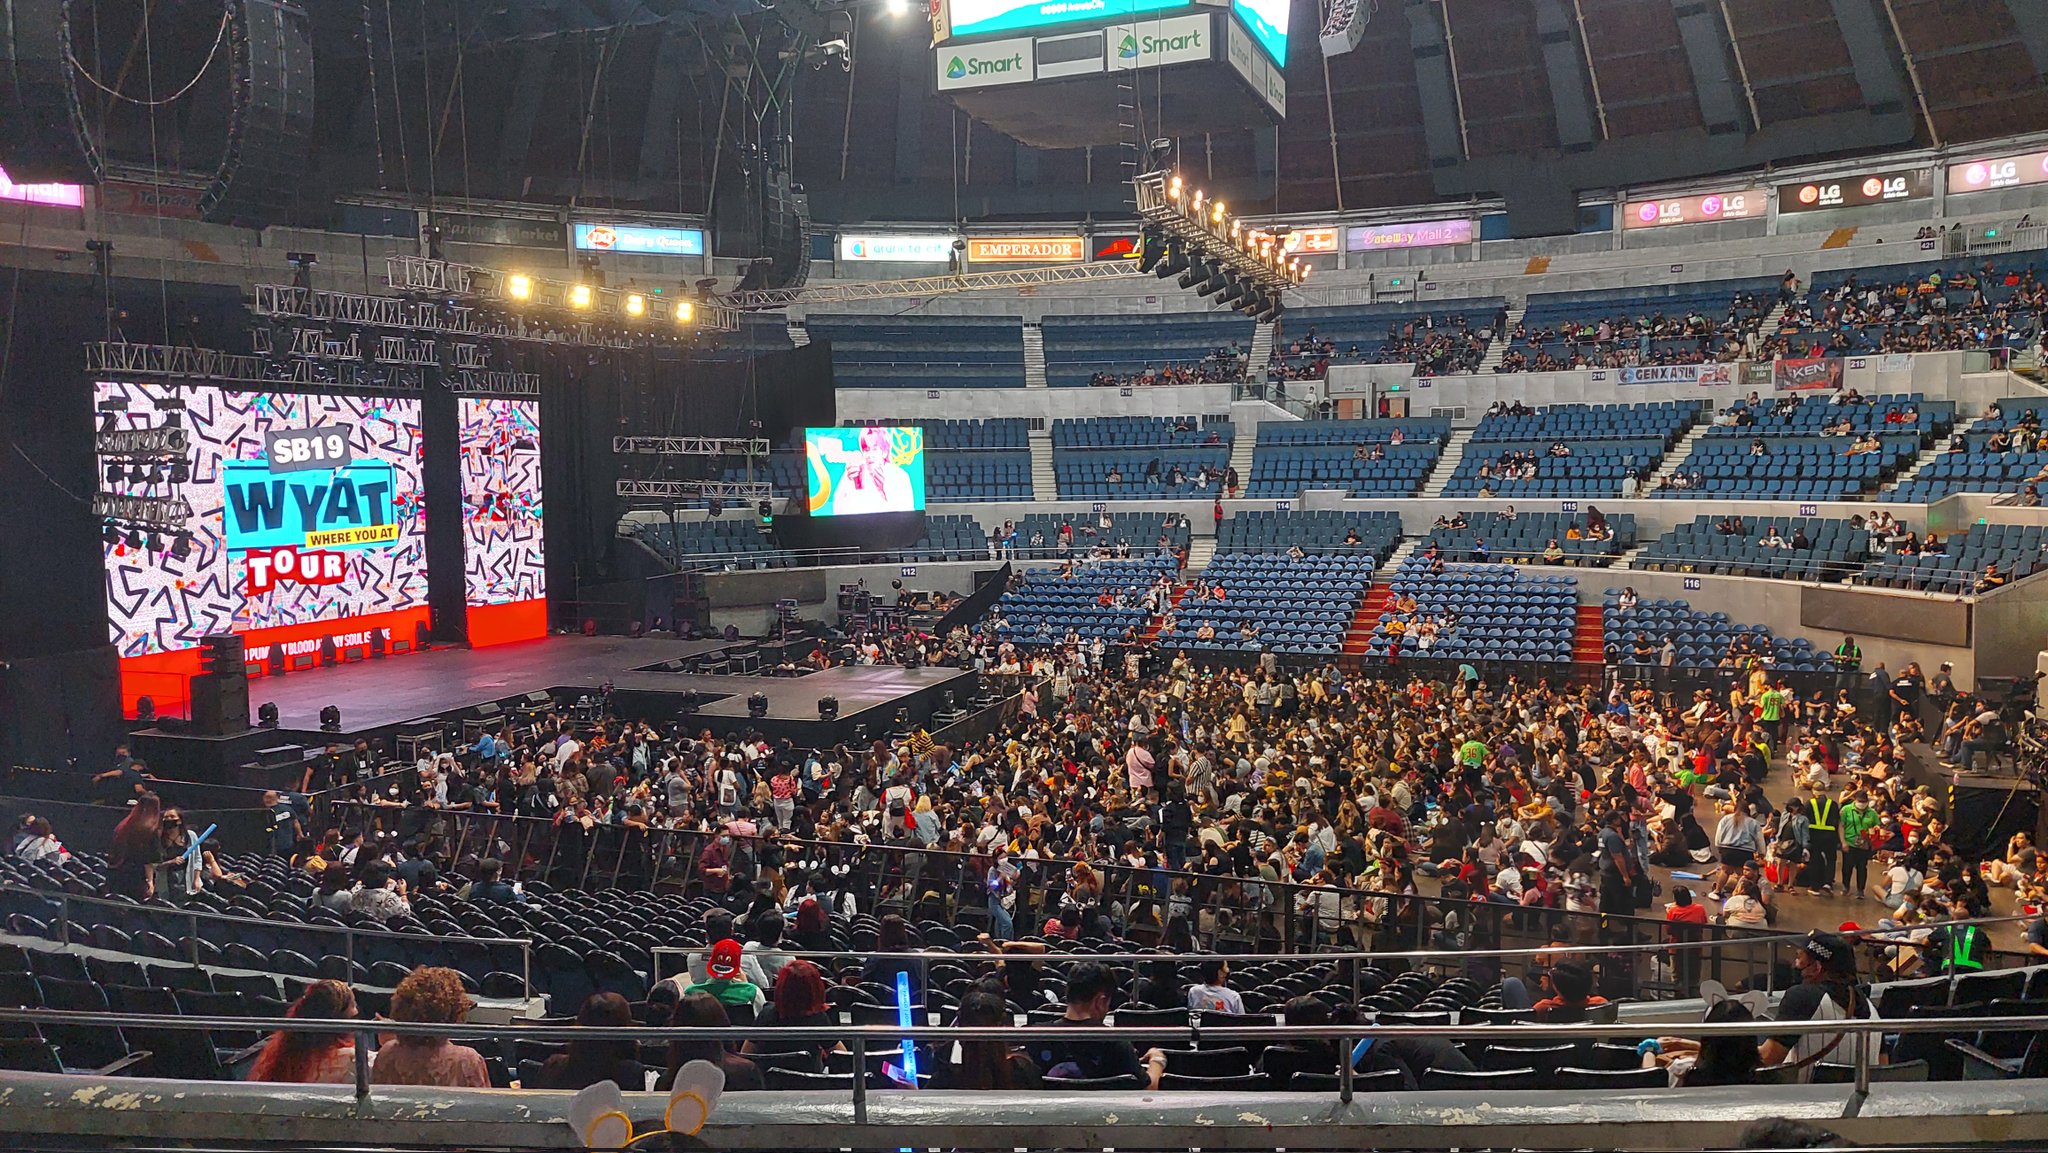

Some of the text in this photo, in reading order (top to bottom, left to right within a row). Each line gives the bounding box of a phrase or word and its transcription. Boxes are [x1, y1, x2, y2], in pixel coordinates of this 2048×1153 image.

[1142, 29, 1201, 53] Smart
[968, 52, 1022, 75] Smart
[1990, 161, 2016, 180] LG
[1820, 185, 1840, 199] LG
[1884, 177, 1906, 192] LG
[1660, 203, 1680, 217] LG
[1723, 196, 1744, 210] LG
[656, 235, 693, 248] Queen
[1417, 229, 1441, 240] Mall
[980, 243, 1072, 257] EMPERADOR
[1793, 362, 1826, 378] KEN
[1851, 360, 1865, 368] 219
[273, 434, 344, 464] SB19
[226, 477, 389, 534] WYAT
[1801, 506, 1815, 515] 116
[310, 528, 393, 546] WHERE YOU AT
[249, 549, 342, 588] TOUR
[1685, 580, 1699, 588] 116
[288, 639, 315, 655] BLOOD
[344, 632, 364, 647] SOUL
